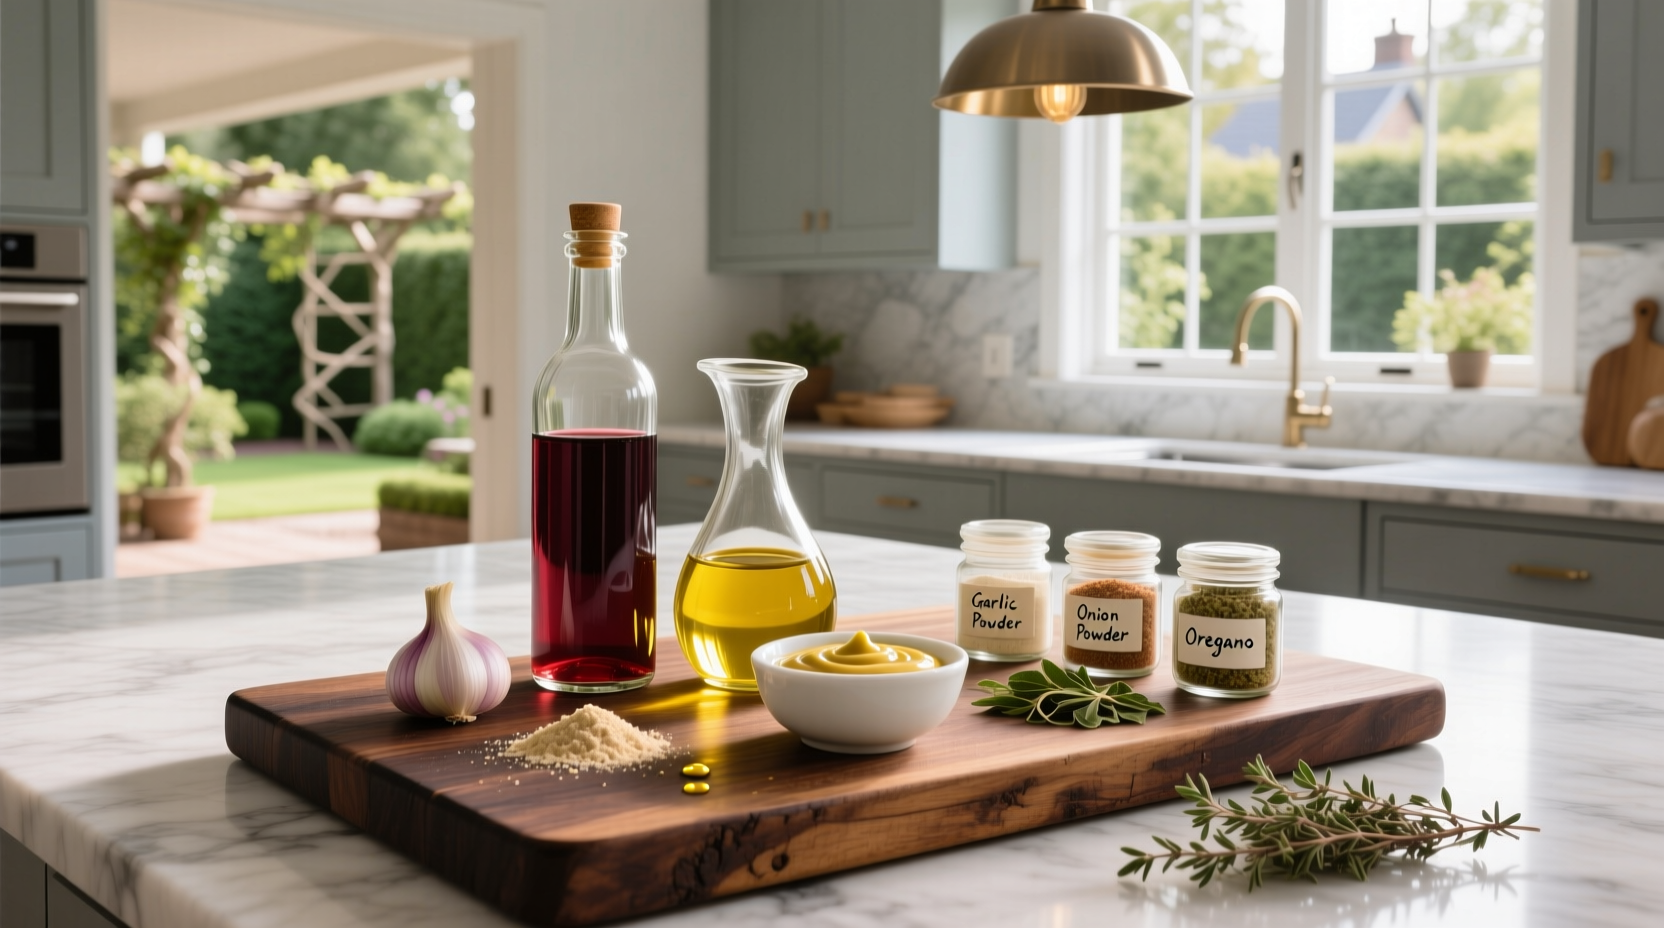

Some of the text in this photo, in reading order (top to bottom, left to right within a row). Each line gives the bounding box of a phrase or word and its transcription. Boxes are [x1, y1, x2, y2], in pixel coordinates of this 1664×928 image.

[971, 591, 1018, 611] Garlic
[1077, 603, 1119, 622] Onion
[1076, 623, 1129, 642] Powder
[1185, 626, 1254, 658] Oregano
